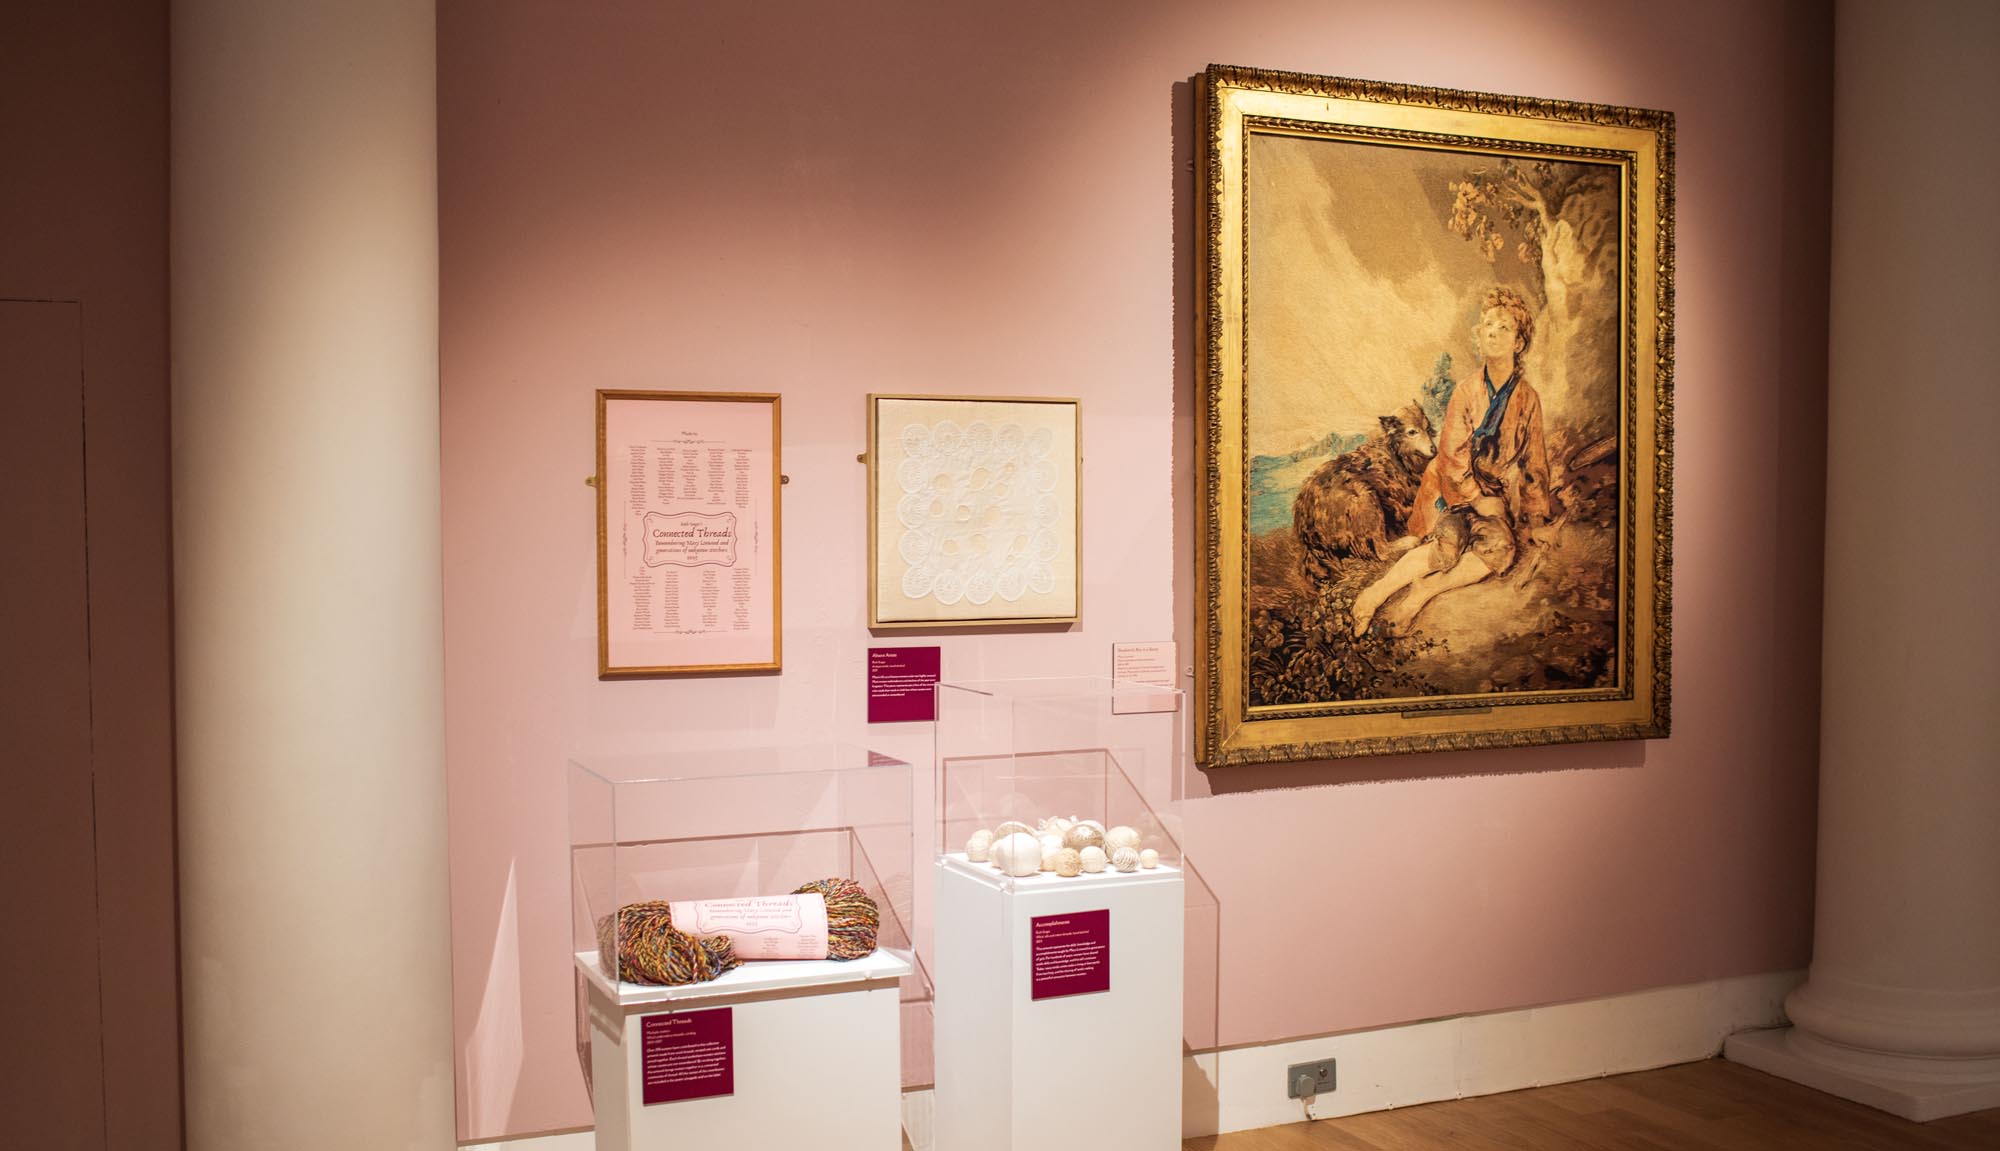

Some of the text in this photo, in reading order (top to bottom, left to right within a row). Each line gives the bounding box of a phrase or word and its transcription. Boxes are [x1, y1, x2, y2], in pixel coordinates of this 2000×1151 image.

[653, 526, 732, 538] Connected Threads
[646, 1020, 672, 1028] Connected
